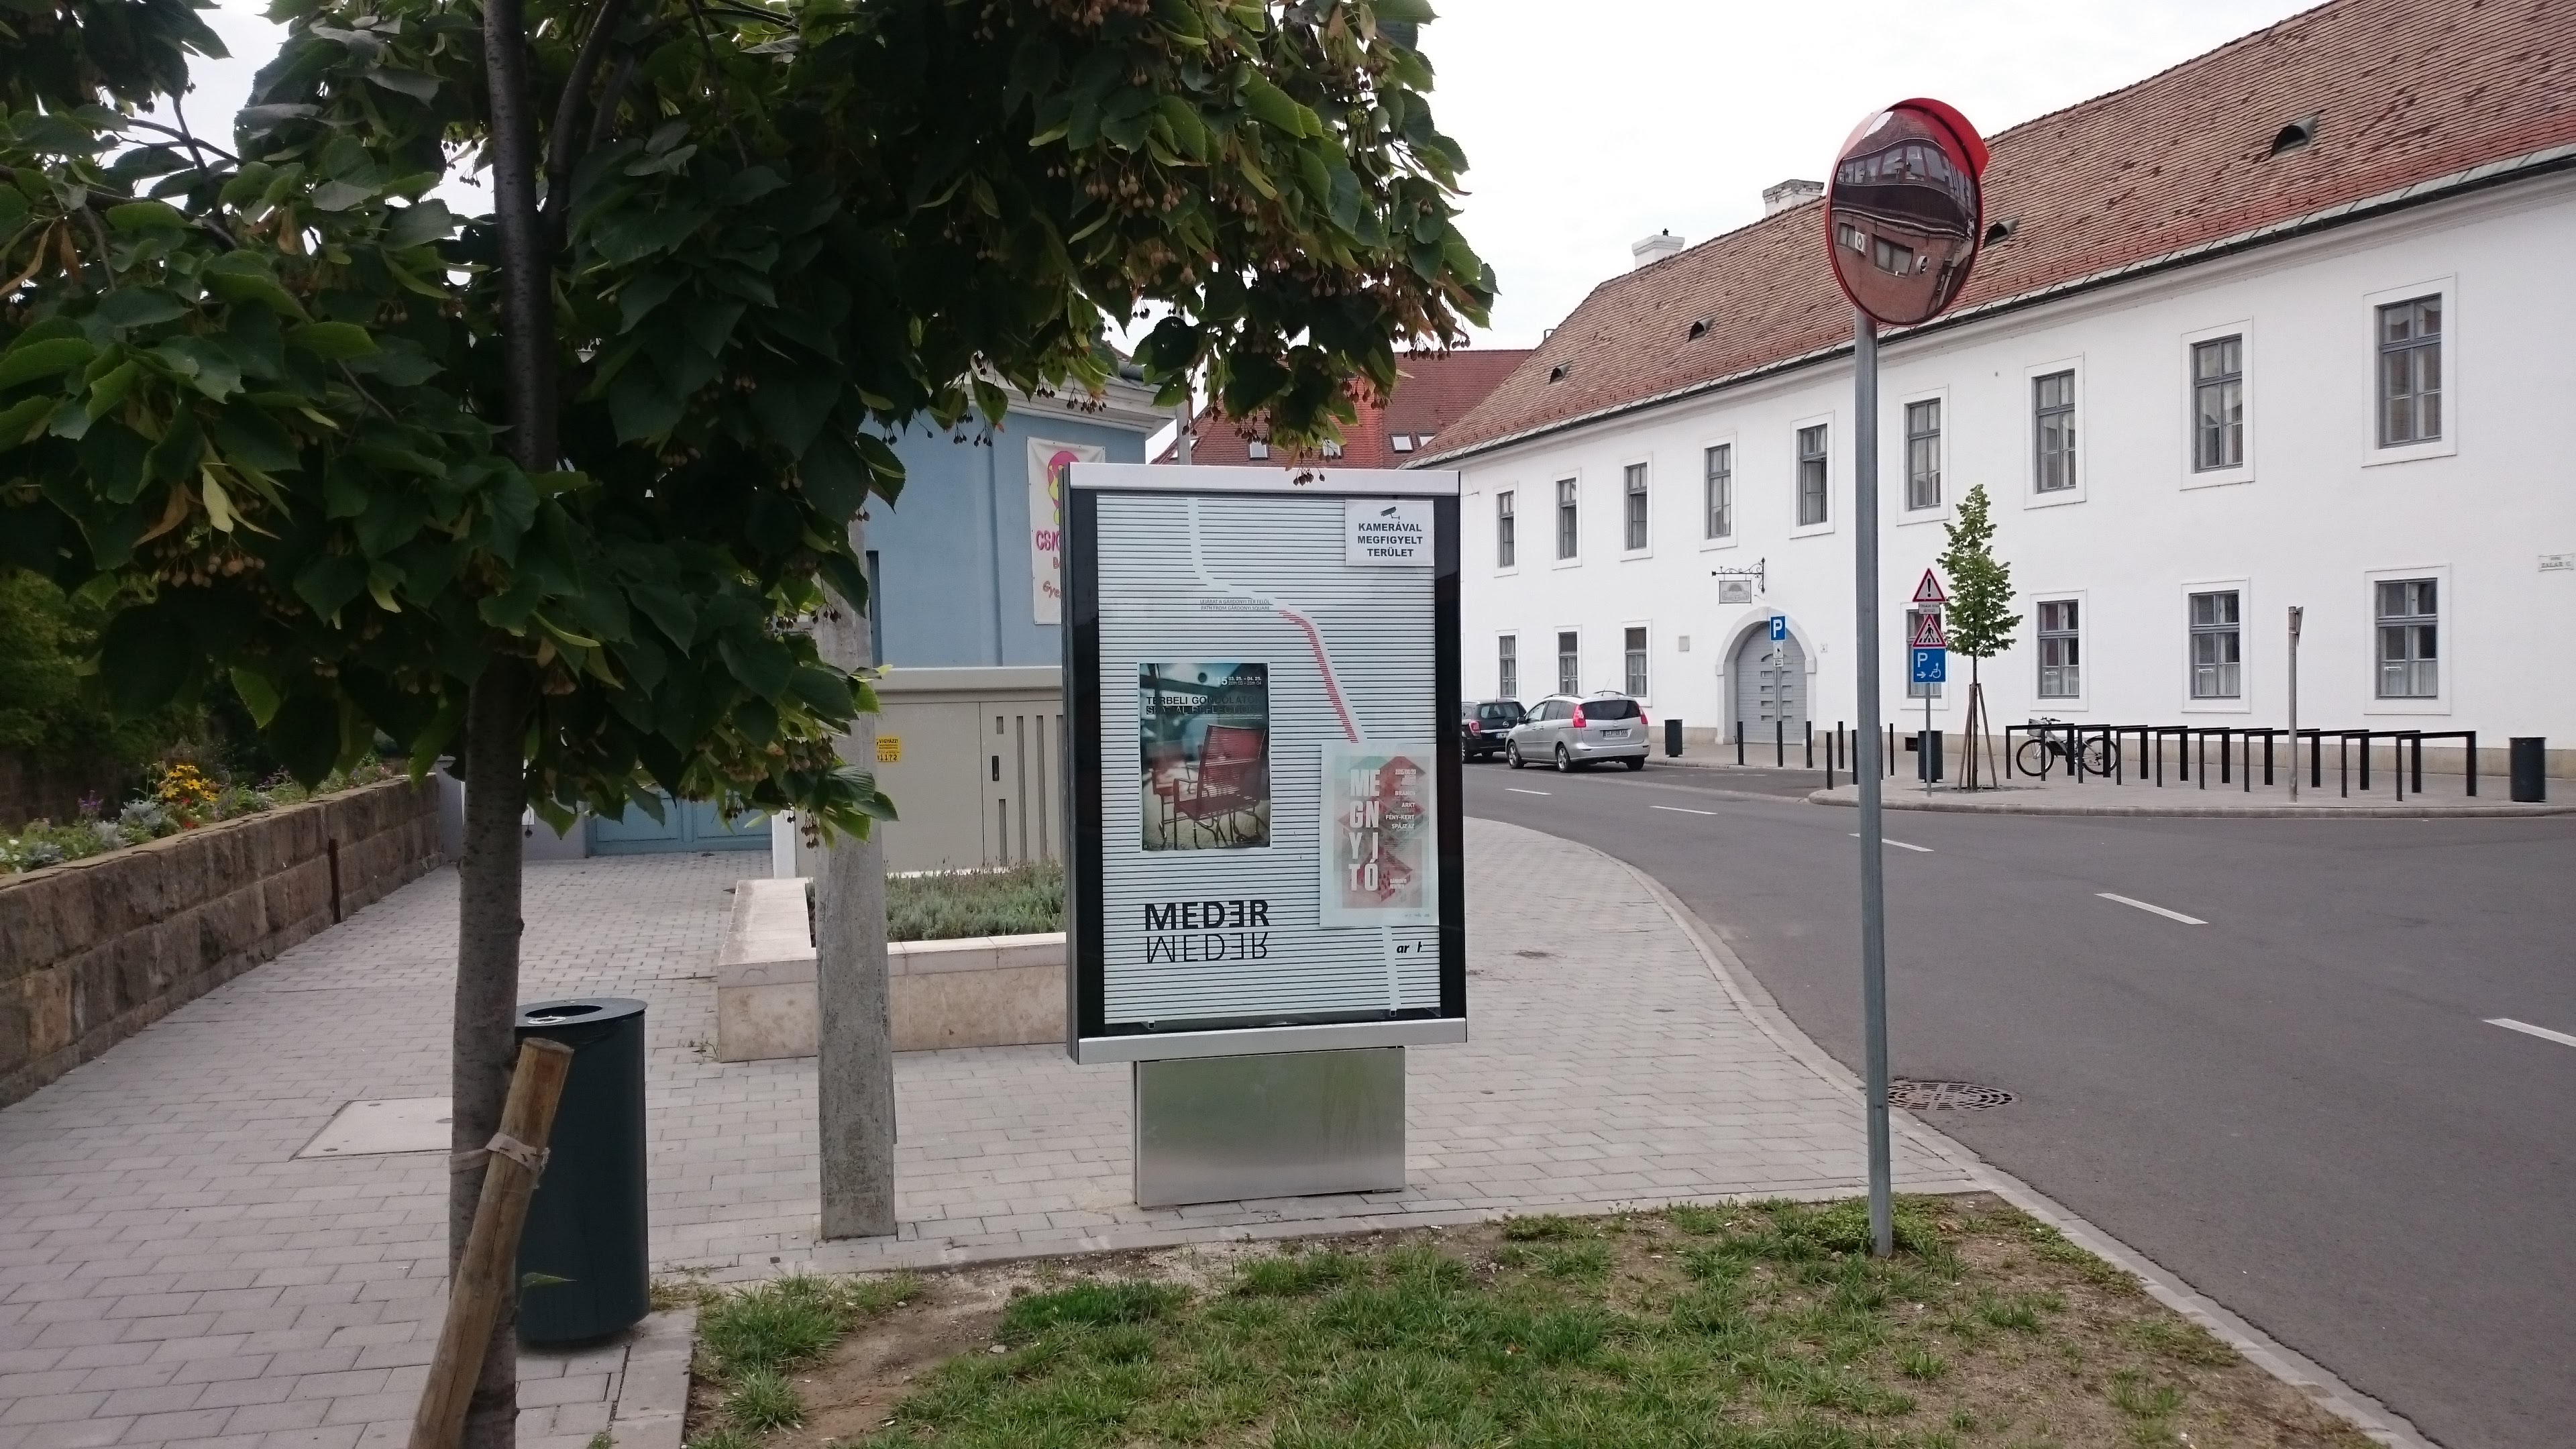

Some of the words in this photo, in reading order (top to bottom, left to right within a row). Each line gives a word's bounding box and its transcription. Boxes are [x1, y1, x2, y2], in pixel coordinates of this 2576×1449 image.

[1358, 521, 1422, 532] KAMERÁVAL
[1357, 535, 1423, 545] MEGFIGYELT
[1366, 547, 1414, 557] TERÜLET
[1042, 580, 1061, 599] Gye
[1773, 619, 1783, 638] P
[1917, 652, 1928, 668] P
